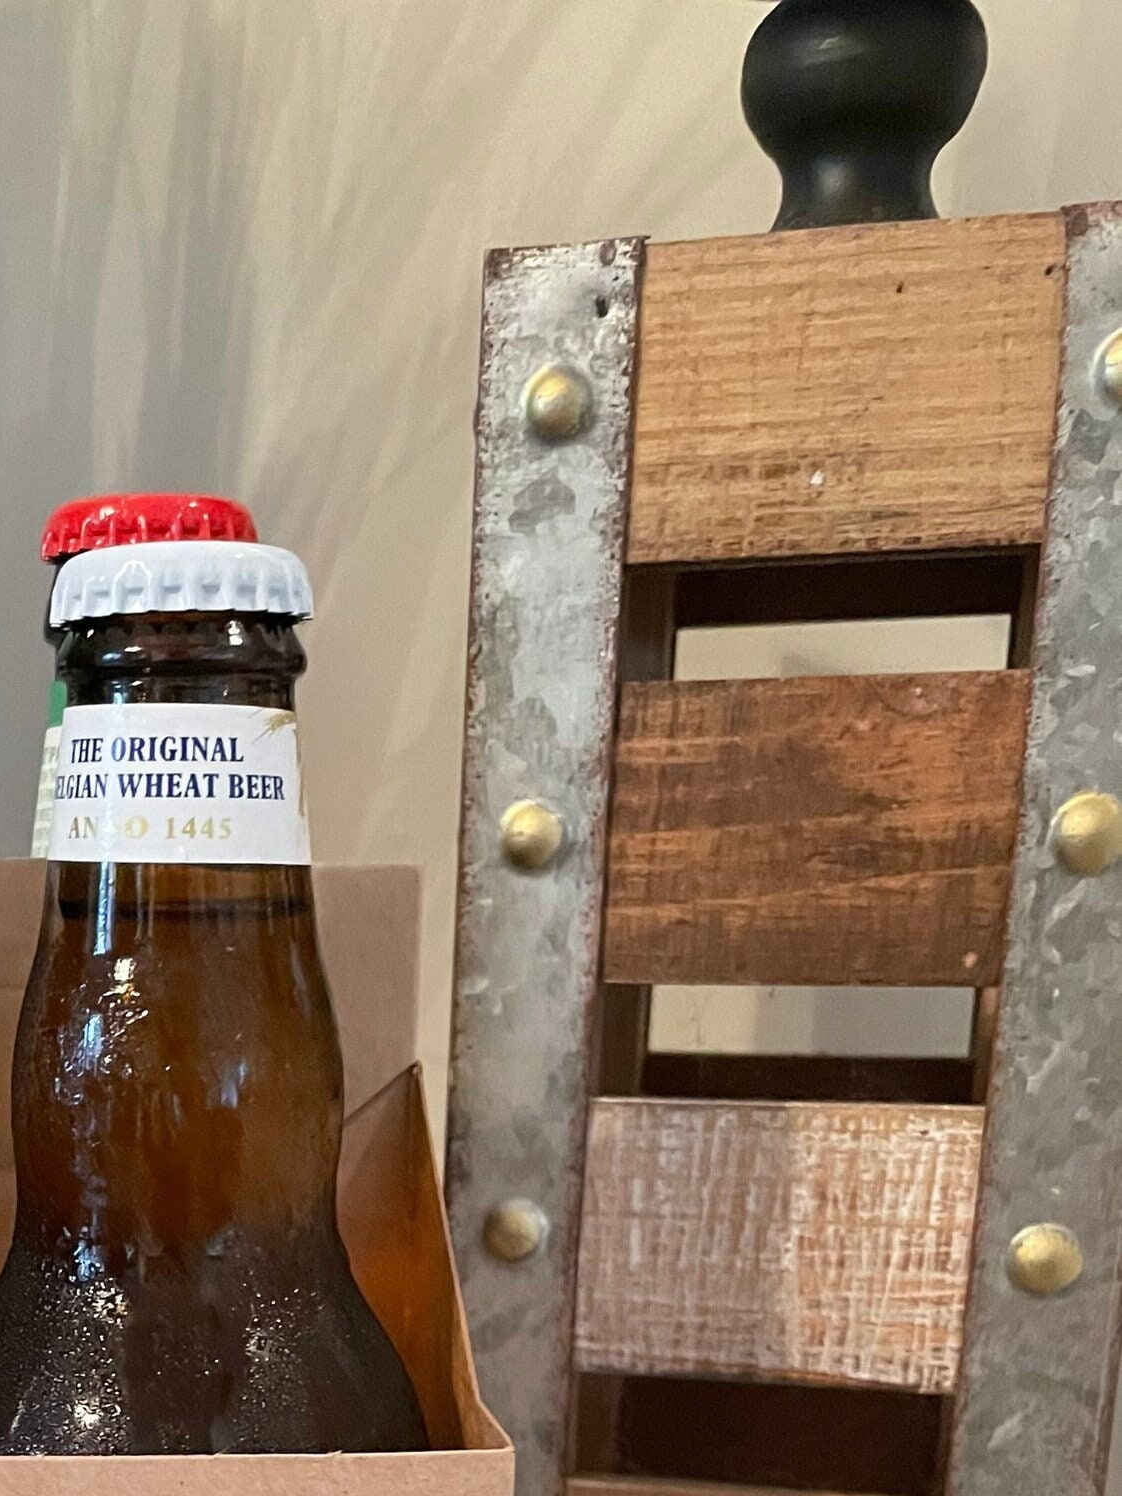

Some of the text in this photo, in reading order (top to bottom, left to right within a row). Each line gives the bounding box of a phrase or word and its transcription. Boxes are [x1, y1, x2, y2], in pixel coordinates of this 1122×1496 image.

[71, 736, 244, 764] THE ORIGINAL
[55, 773, 285, 800] ELGIAN WHEAT BEER
[68, 816, 232, 839] ANO 1445
